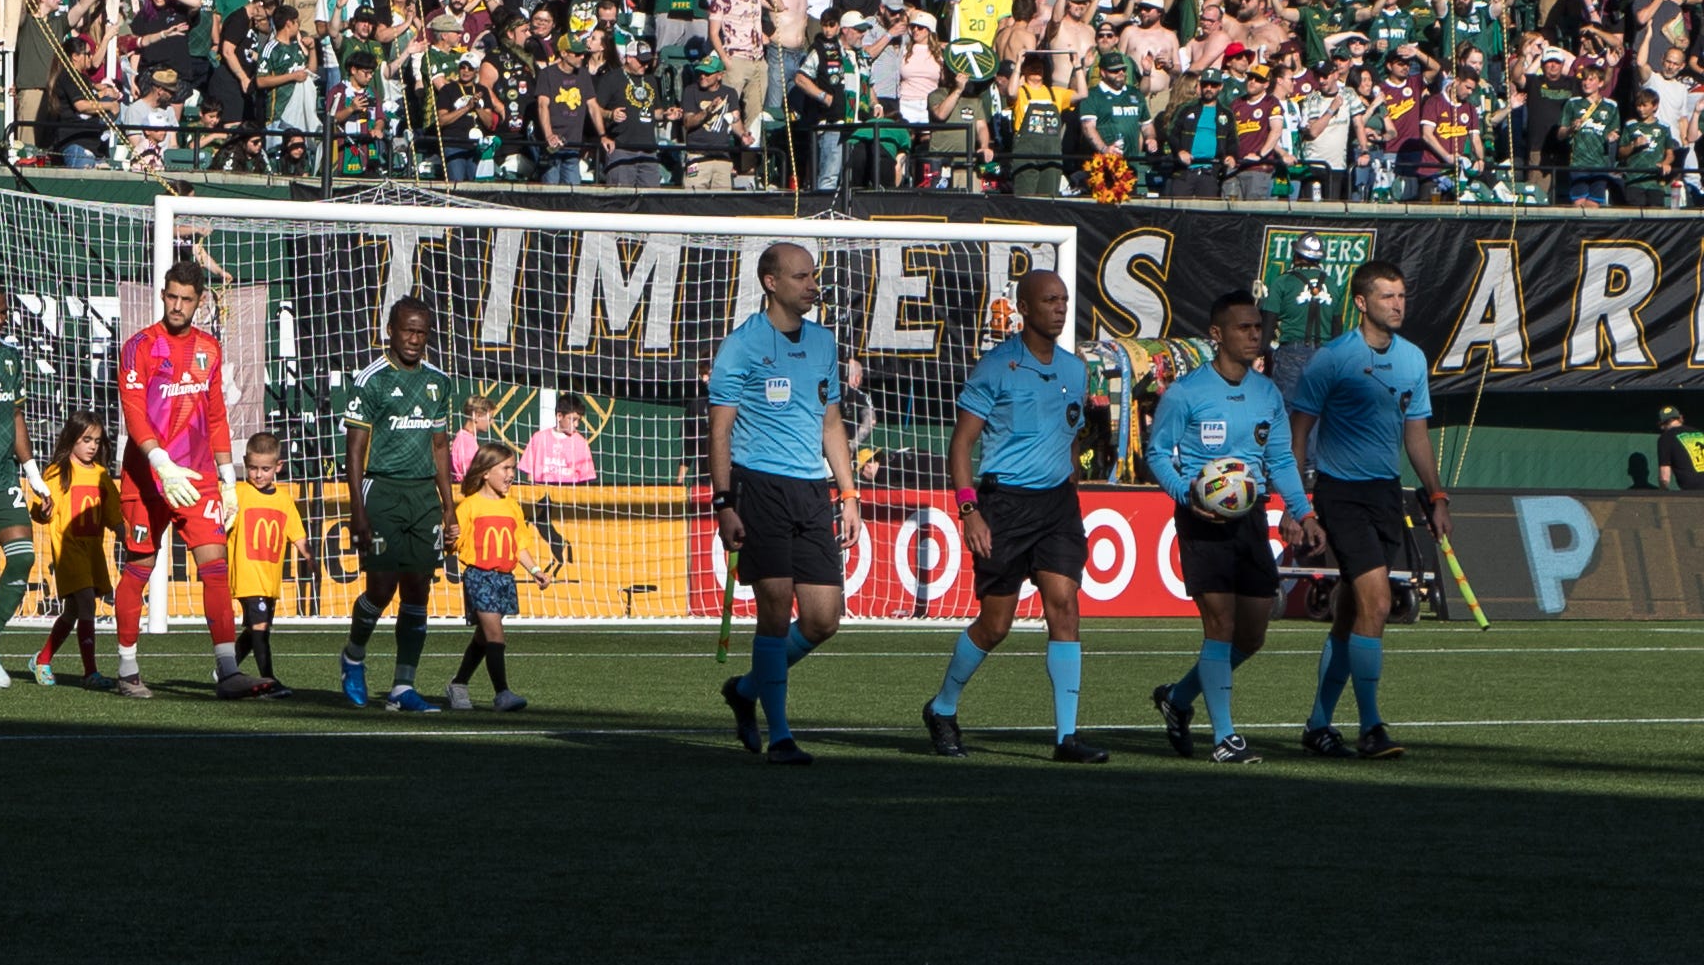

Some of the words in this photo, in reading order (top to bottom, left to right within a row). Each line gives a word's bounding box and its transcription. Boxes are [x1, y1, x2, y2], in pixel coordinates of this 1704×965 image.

[968, 19, 986, 32] 20
[1379, 28, 1389, 39] NO
[1112, 105, 1122, 116] NO
[1123, 105, 1139, 116] PITY
[1274, 236, 1366, 262] TIERS
[768, 379, 789, 389] FIFA
[389, 415, 434, 430] Tillamo
[1203, 423, 1224, 432] FIFA
[202, 499, 226, 524] 41
